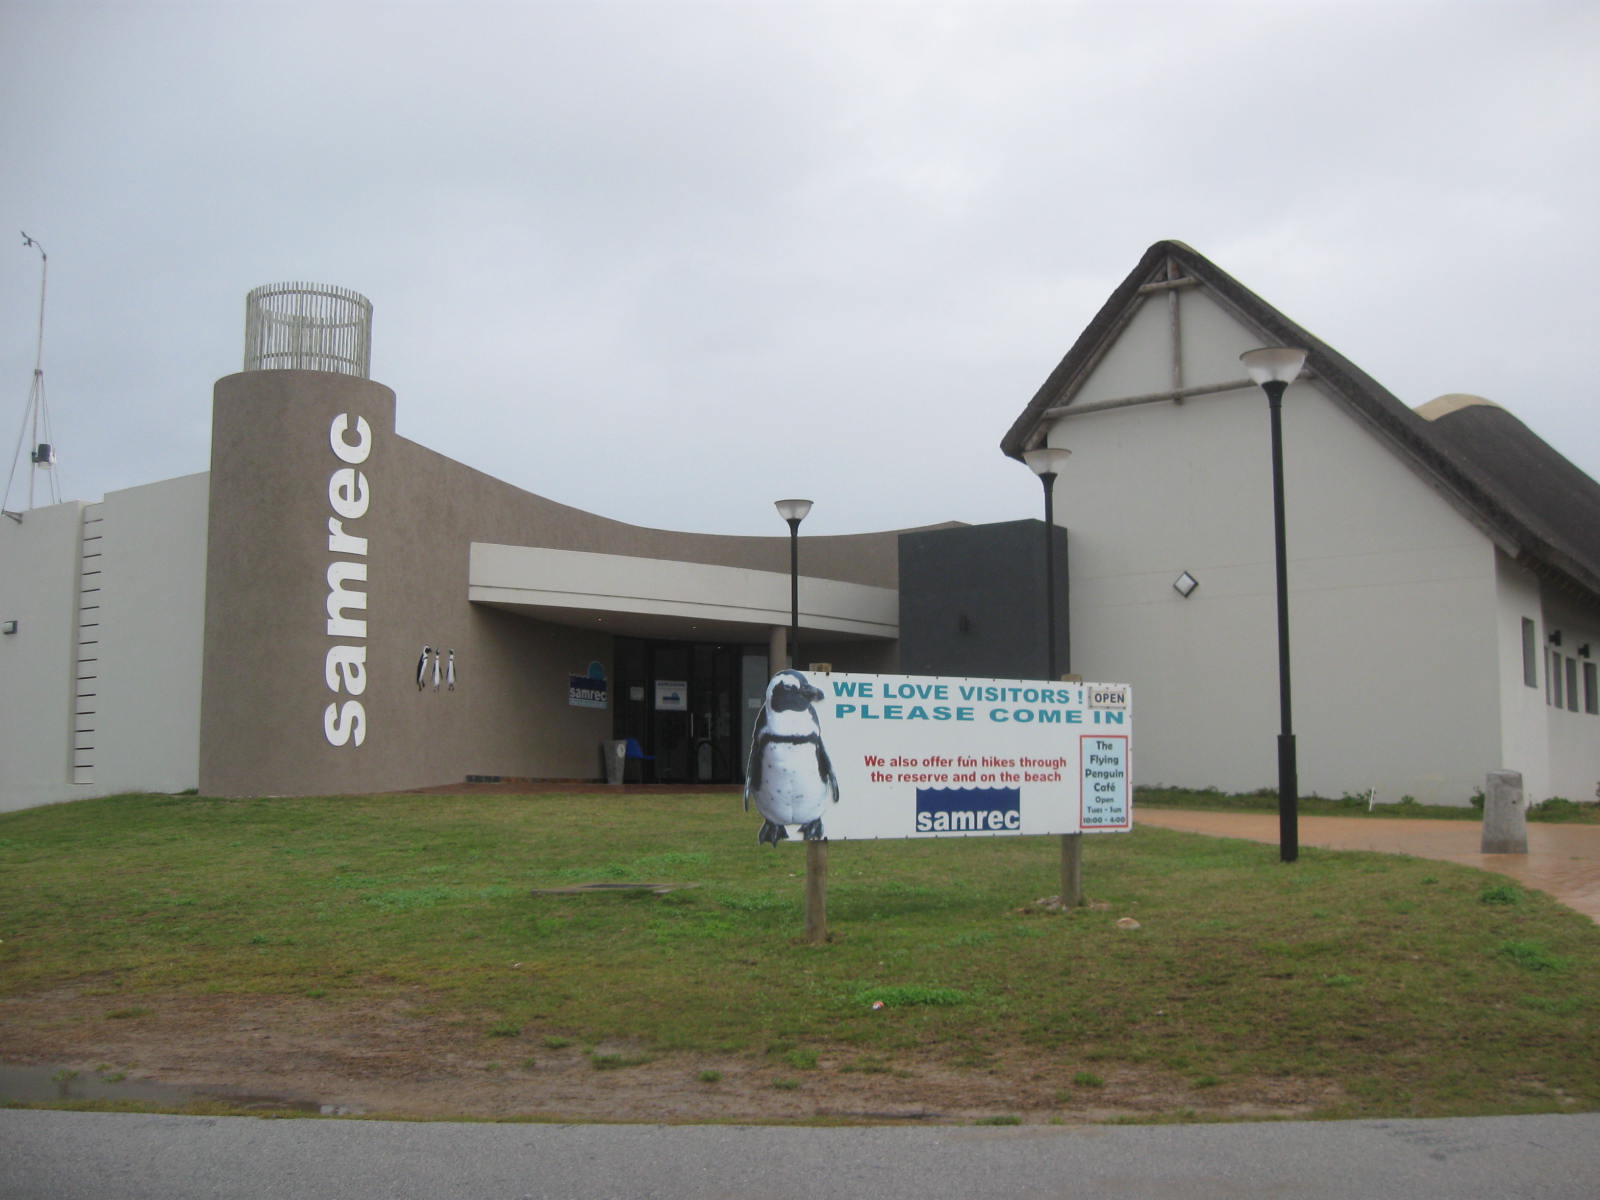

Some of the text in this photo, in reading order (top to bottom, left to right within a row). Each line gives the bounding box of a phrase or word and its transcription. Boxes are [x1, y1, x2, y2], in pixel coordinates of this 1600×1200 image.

[324, 413, 372, 747] samrec
[569, 687, 607, 702] samrec
[832, 682, 873, 698] WE
[884, 683, 949, 700] LOVE
[959, 686, 1070, 704] VISITORS
[1094, 692, 1125, 703] OPEN
[836, 704, 1124, 724] PLEASE COME IN
[1096, 741, 1113, 750] The
[864, 756, 1067, 770] We also offer fun hikes through
[1090, 755, 1119, 765] Flying
[871, 771, 1061, 782] the reserve and on the beach
[1085, 769, 1123, 779] Penguin
[1094, 783, 1116, 791] Café
[1095, 796, 1114, 804] Open
[917, 808, 1020, 832] samrec
